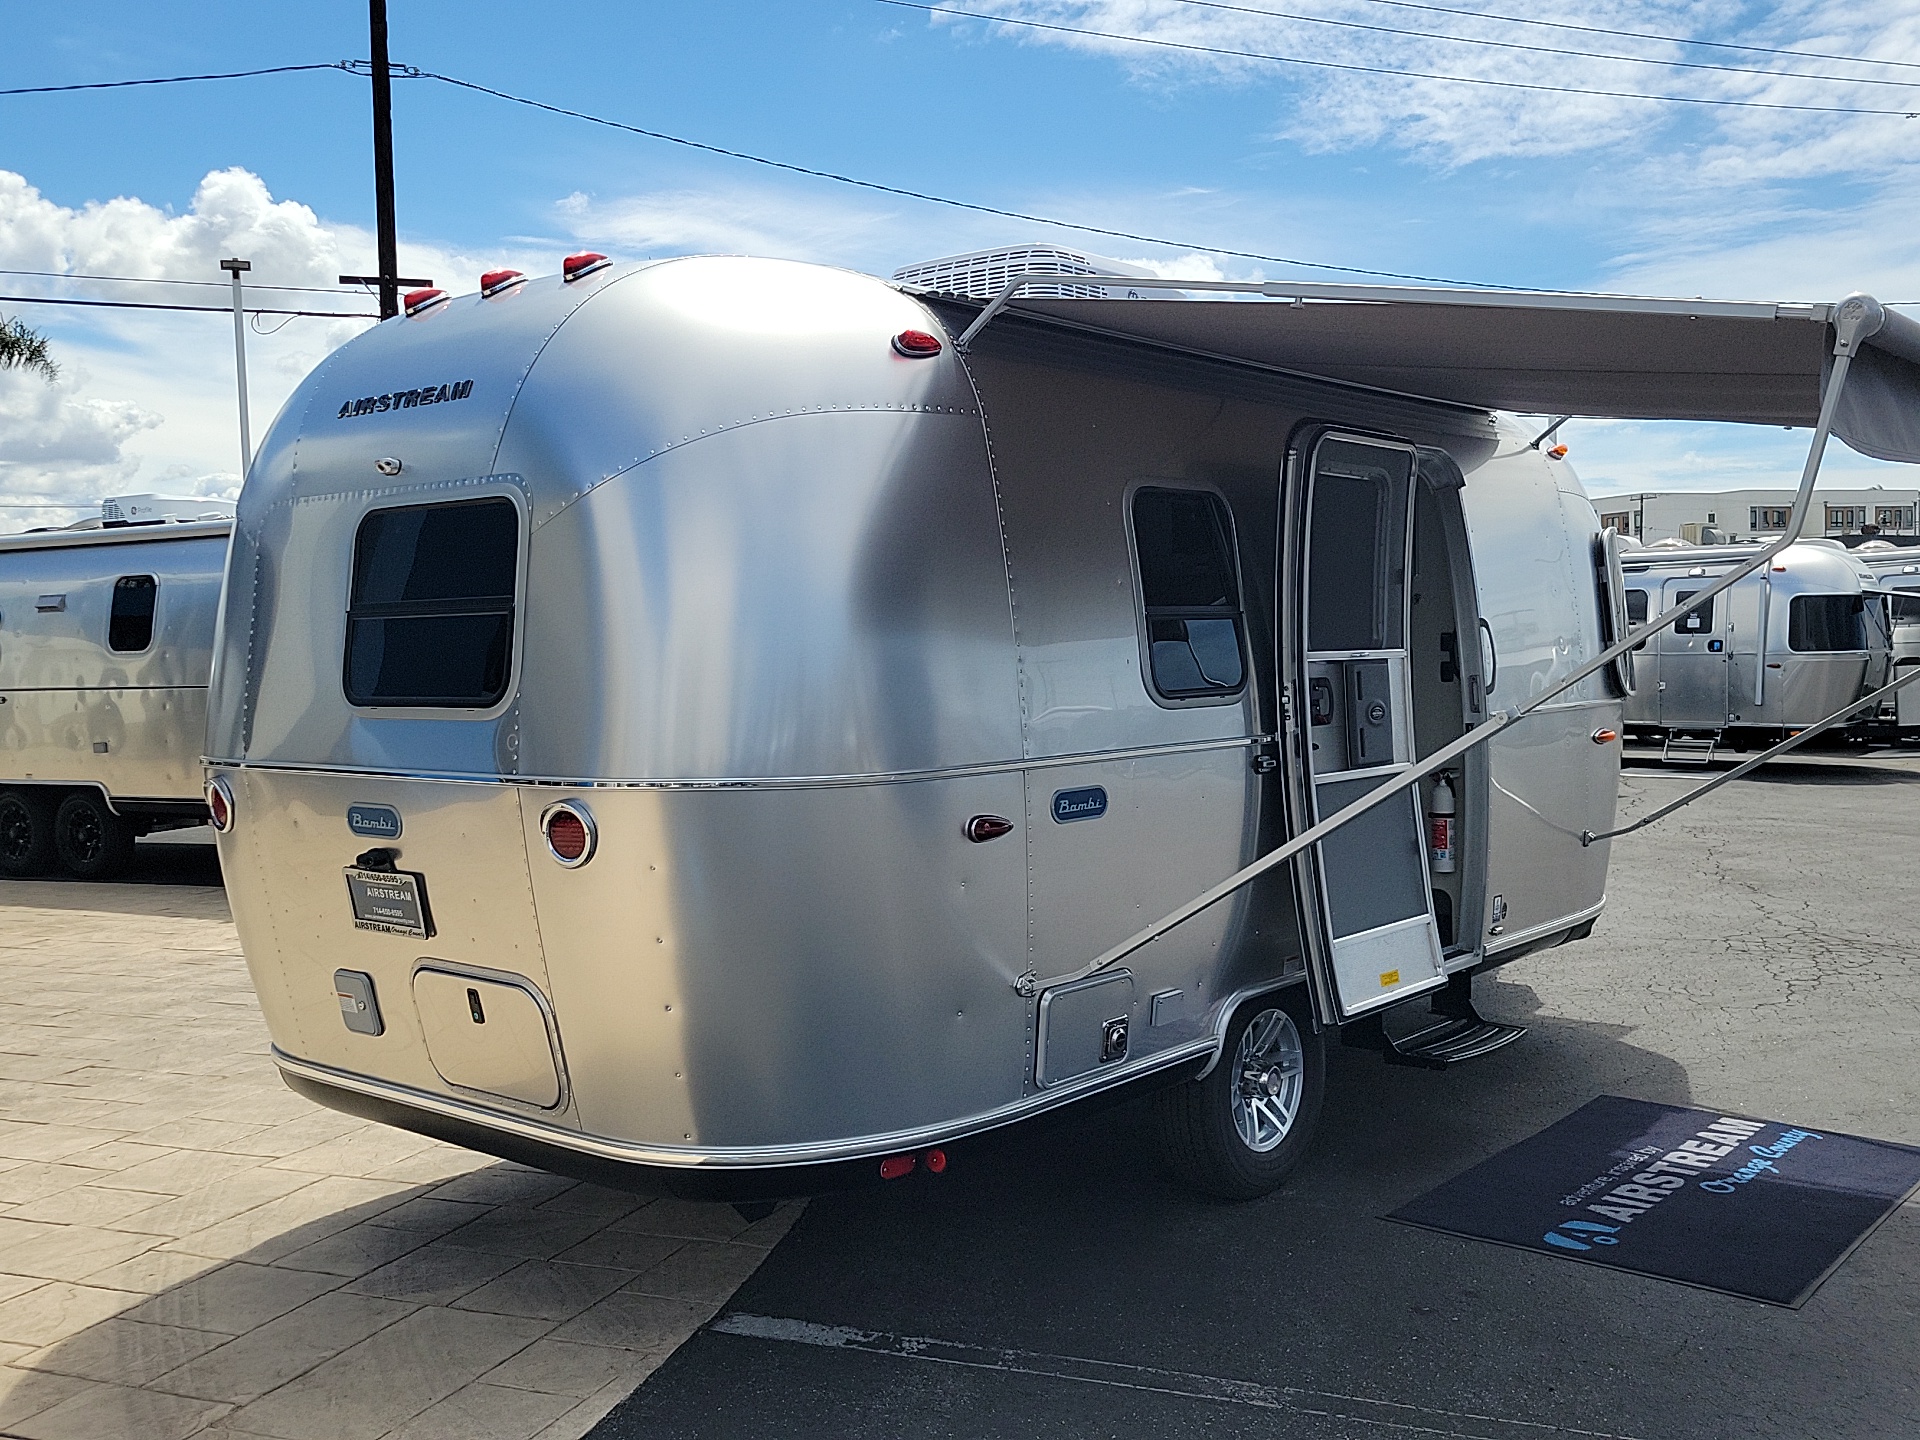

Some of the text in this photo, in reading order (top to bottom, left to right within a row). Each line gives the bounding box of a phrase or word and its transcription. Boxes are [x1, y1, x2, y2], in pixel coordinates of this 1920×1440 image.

[337, 379, 474, 419] AIRSTREAM
[1059, 798, 1103, 814] Bambi
[352, 813, 396, 830] Bambi
[366, 887, 412, 901] AIRSTREAM
[354, 920, 392, 934] AIRSTREAM
[1587, 1116, 1767, 1223] AIRSTREAM
[1700, 1128, 1823, 1194] Orange County
